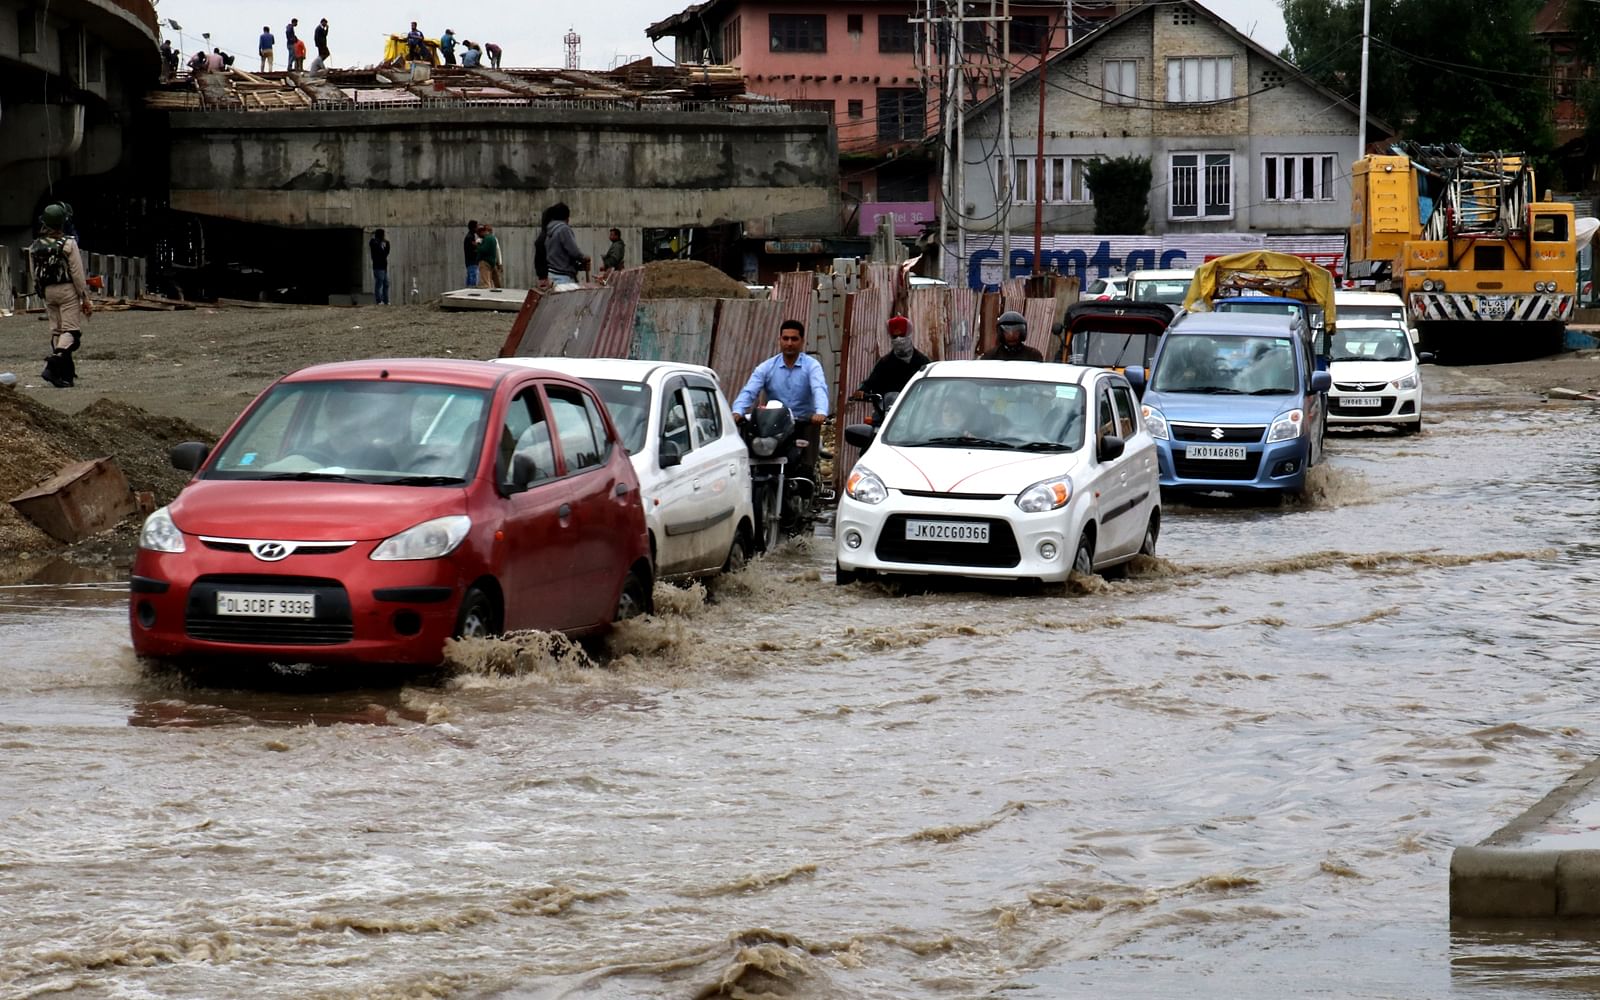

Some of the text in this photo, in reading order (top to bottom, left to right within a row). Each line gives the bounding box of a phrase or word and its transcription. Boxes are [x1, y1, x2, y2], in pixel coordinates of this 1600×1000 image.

[1192, 447, 1245, 458] JK01AG4861
[915, 524, 988, 540] JK02CG0366
[226, 598, 311, 614] DL3CBF 9336
